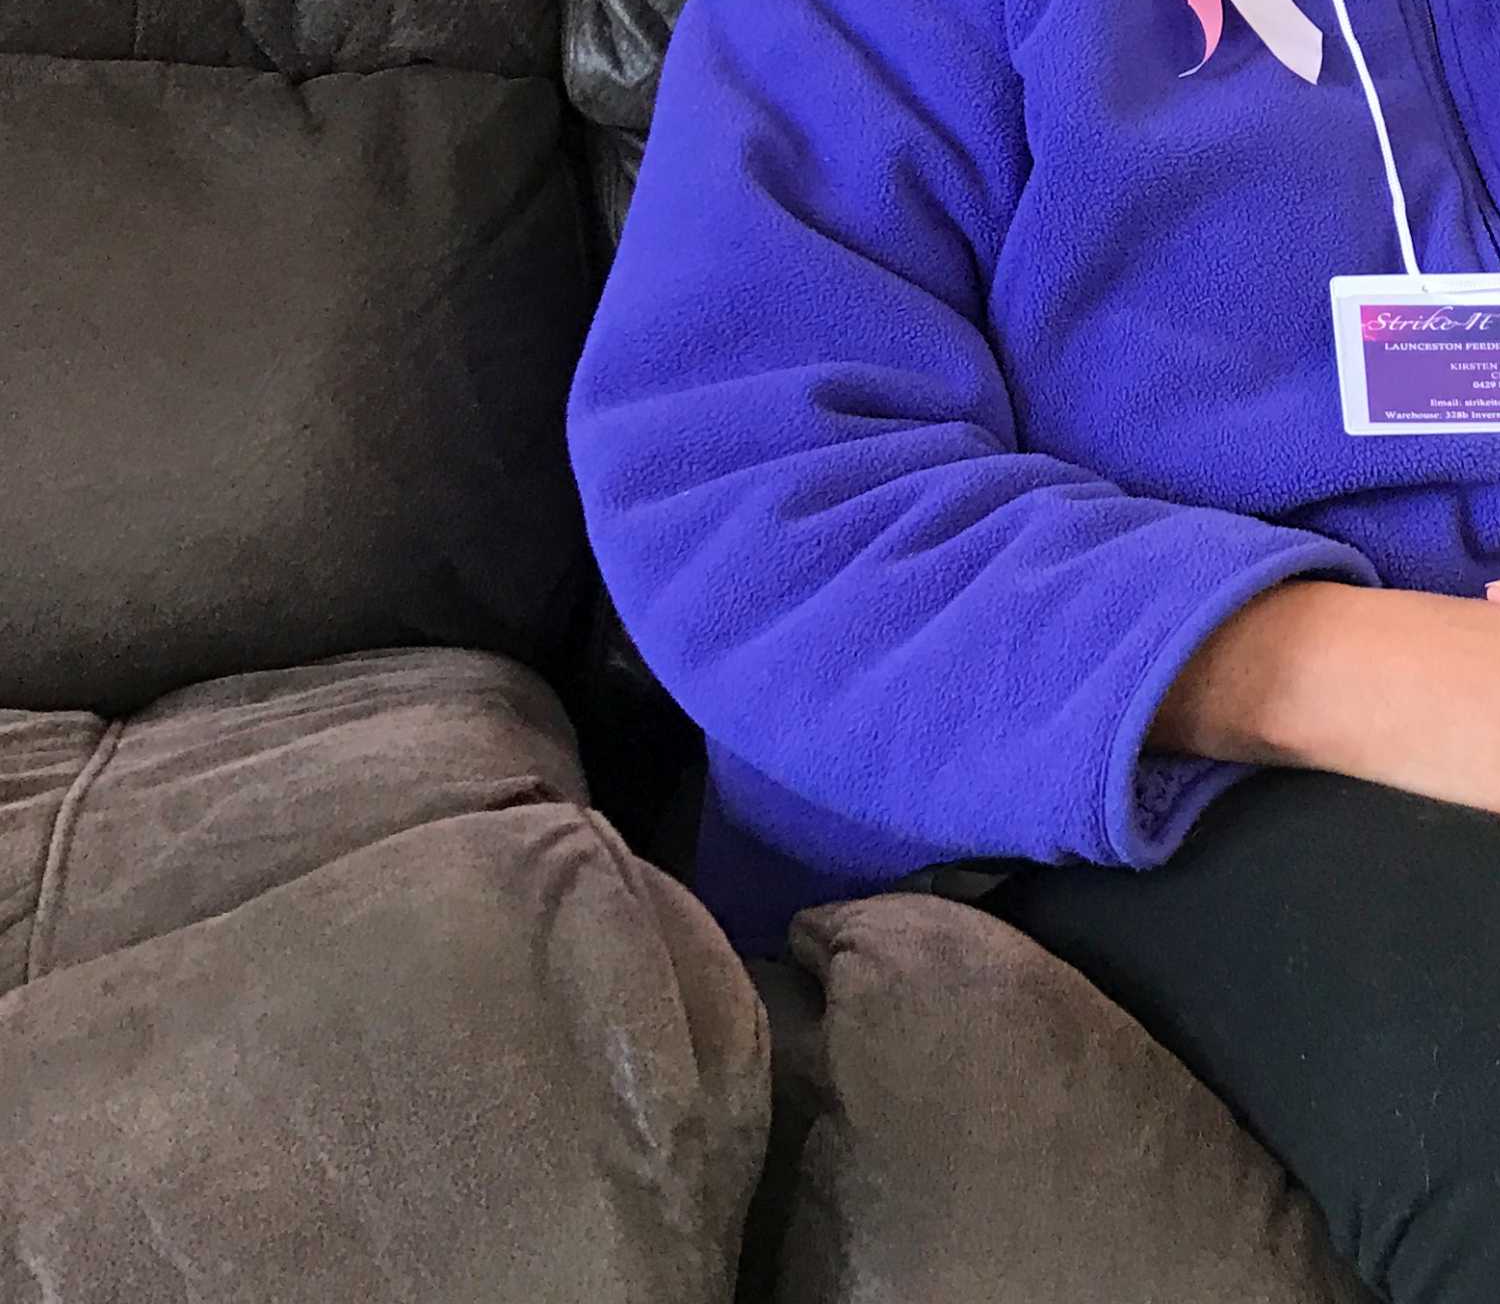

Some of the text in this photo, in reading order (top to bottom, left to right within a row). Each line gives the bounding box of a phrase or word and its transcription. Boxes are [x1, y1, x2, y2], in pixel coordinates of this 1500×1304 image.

[1368, 305, 1454, 331] Strike
[1465, 311, 1492, 331] It
[1384, 342, 1463, 351] LAUNCESTON
[1450, 362, 1498, 371] KIRSTEN
[1430, 398, 1462, 407] Email:
[1385, 411, 1443, 419] Warehouse:
